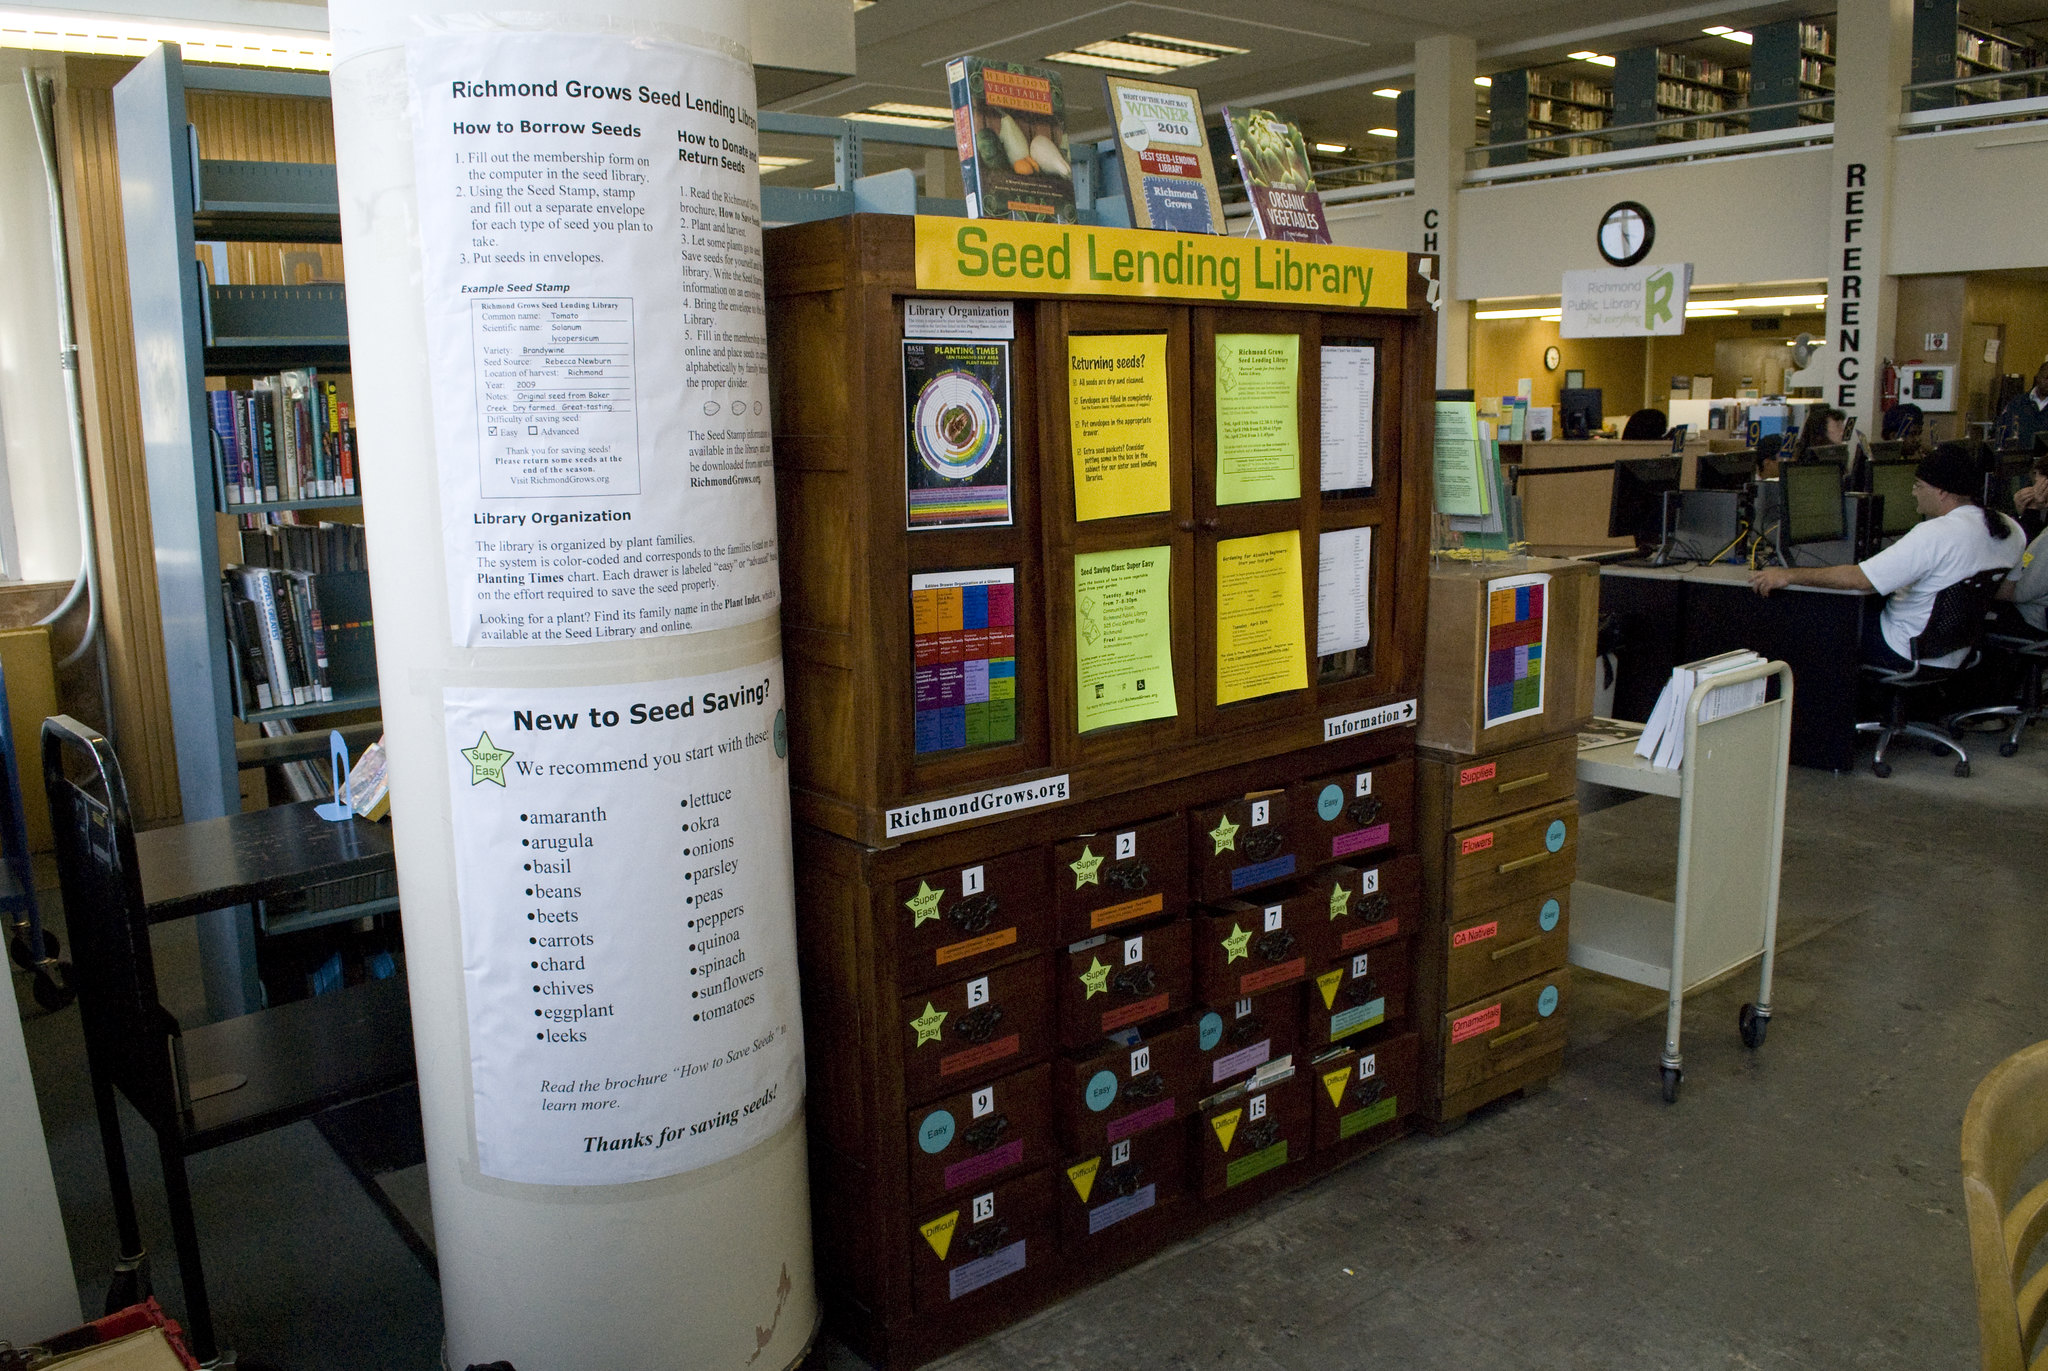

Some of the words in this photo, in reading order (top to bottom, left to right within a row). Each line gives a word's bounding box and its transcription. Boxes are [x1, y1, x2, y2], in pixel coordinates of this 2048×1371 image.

[987, 83, 1048, 102] VEGETABLE
[452, 80, 558, 99] Richmond
[565, 80, 632, 101] Grows
[639, 86, 681, 108] Seed
[686, 92, 736, 124] Lending
[1125, 101, 1192, 122] WINNER
[453, 121, 494, 135] How
[496, 121, 514, 134] to
[520, 120, 585, 135] Borrow
[592, 122, 642, 138] Seeds
[1158, 122, 1188, 136] 2010
[678, 130, 706, 146] How
[708, 136, 720, 148] to
[722, 138, 748, 158] Donate
[455, 153, 465, 164] 1.
[468, 152, 487, 164] Fill
[491, 153, 508, 164] out
[512, 152, 530, 164] the
[534, 152, 605, 167] membership
[609, 152, 634, 166] form
[638, 158, 650, 167] on
[679, 149, 718, 167] Return
[720, 156, 746, 174] Seeds
[1140, 152, 1155, 161] BEST
[1156, 154, 1197, 166] SEED-LENDING
[1158, 164, 1182, 174] LIBRARY
[1154, 186, 1198, 200] Richmond
[1164, 200, 1193, 210] Grows
[1268, 191, 1308, 212] ORGANIC
[1268, 208, 1320, 230] VEGETABLES
[957, 227, 1070, 278] Seed
[1088, 234, 1241, 300] Lending
[1254, 246, 1374, 307] Library
[461, 284, 504, 294] Example
[506, 283, 532, 292] Seed
[536, 282, 570, 294] Stamp
[1588, 281, 1642, 294] Richmond
[1838, 163, 1866, 408] REFERENCE
[908, 305, 945, 318] Library
[948, 306, 1010, 318] Organization
[1568, 300, 1598, 312] Public
[1603, 299, 1640, 310] Library
[482, 312, 514, 320] Common
[518, 312, 541, 320] name:
[522, 346, 565, 356] Brandywine
[546, 358, 576, 366] Rebecca
[578, 358, 612, 366] Newburn
[1072, 356, 1114, 372] Returning
[1116, 354, 1146, 368] seeds?
[568, 368, 604, 376] Richmond
[516, 381, 536, 389] 2009
[328, 394, 339, 432] WATCHMEN
[262, 422, 273, 451] JAZZ
[1750, 422, 1760, 446] 9
[474, 512, 526, 526] Library
[531, 509, 632, 526] Organization
[476, 540, 496, 552] The
[499, 540, 534, 554] library
[538, 540, 548, 551] is
[551, 538, 606, 554] organized
[609, 537, 622, 552] by
[626, 536, 652, 550] plant
[656, 534, 695, 547] families.
[514, 710, 578, 731] New
[589, 707, 620, 728] to
[630, 696, 694, 724] Seed
[702, 678, 770, 714] Saving?
[1328, 710, 1400, 738] Information
[472, 750, 502, 762] Super
[516, 760, 544, 776] We
[550, 754, 648, 776] recommend
[653, 752, 680, 770] you
[686, 745, 714, 762] start
[718, 736, 742, 755] with
[744, 730, 770, 750] these:
[476, 764, 500, 778] Easy
[1462, 768, 1493, 783] Supplies
[1360, 778, 1368, 791] 4
[690, 788, 732, 809] lettuce
[890, 780, 1066, 830] RichmondGrows.org
[530, 808, 607, 825] amaranth
[1256, 807, 1264, 821] 3
[690, 816, 720, 833] okra
[1215, 825, 1235, 838] Super
[531, 833, 594, 852] arugula
[692, 836, 734, 858] onions
[1120, 838, 1130, 854] 2
[1217, 838, 1232, 850] Easy
[1463, 836, 1492, 850] Flowers
[533, 859, 572, 874] basil
[693, 859, 740, 885] parsley
[1076, 858, 1098, 870] Super
[969, 874, 977, 890] 1
[1078, 870, 1096, 882] Easy
[1367, 874, 1374, 890] 8
[536, 884, 582, 898] beans
[694, 887, 724, 909] peas
[914, 891, 938, 906] Super
[537, 908, 578, 924] beets
[696, 905, 744, 932] peppers
[916, 904, 938, 920] Easy
[1270, 912, 1277, 926] 7
[538, 932, 594, 948] carrots
[698, 930, 740, 954] quinoa
[1454, 934, 1466, 945] CA
[1468, 926, 1495, 940] Natives
[1130, 944, 1138, 960] 6
[540, 956, 585, 972] chard
[699, 951, 746, 978] spinach
[1354, 959, 1366, 974] 12
[542, 980, 594, 996] chives
[700, 966, 764, 998] sunflowers
[973, 984, 983, 1002] 5
[544, 1004, 614, 1022] eggplant
[702, 994, 756, 1022] tomatoes
[1453, 1008, 1500, 1032] Ornamentals
[546, 1028, 587, 1044] leeks
[541, 1080, 575, 1094] Read
[578, 1080, 600, 1092] the
[604, 1072, 668, 1090] brochure
[712, 1058, 723, 1069] to
[726, 1046, 750, 1064] Save
[1134, 1054, 1148, 1072] 10
[1362, 1061, 1374, 1075] 16
[1326, 1073, 1348, 1086] Difficult
[1093, 1084, 1112, 1098] Easy
[542, 1098, 576, 1112] learn
[581, 1099, 620, 1111] more.
[978, 1094, 988, 1112] 9
[1252, 1100, 1266, 1116] 15
[584, 1134, 653, 1153] Thanks
[656, 1126, 686, 1150] for
[690, 1108, 740, 1136] saving
[742, 1084, 778, 1116] seeds!
[1215, 1116, 1238, 1130] Difficult
[927, 1124, 948, 1140] Easy
[1114, 1144, 1129, 1161] 14
[1072, 1165, 1098, 1181] Difficult
[976, 1198, 993, 1219] 13
[926, 1219, 955, 1238] Difficult
